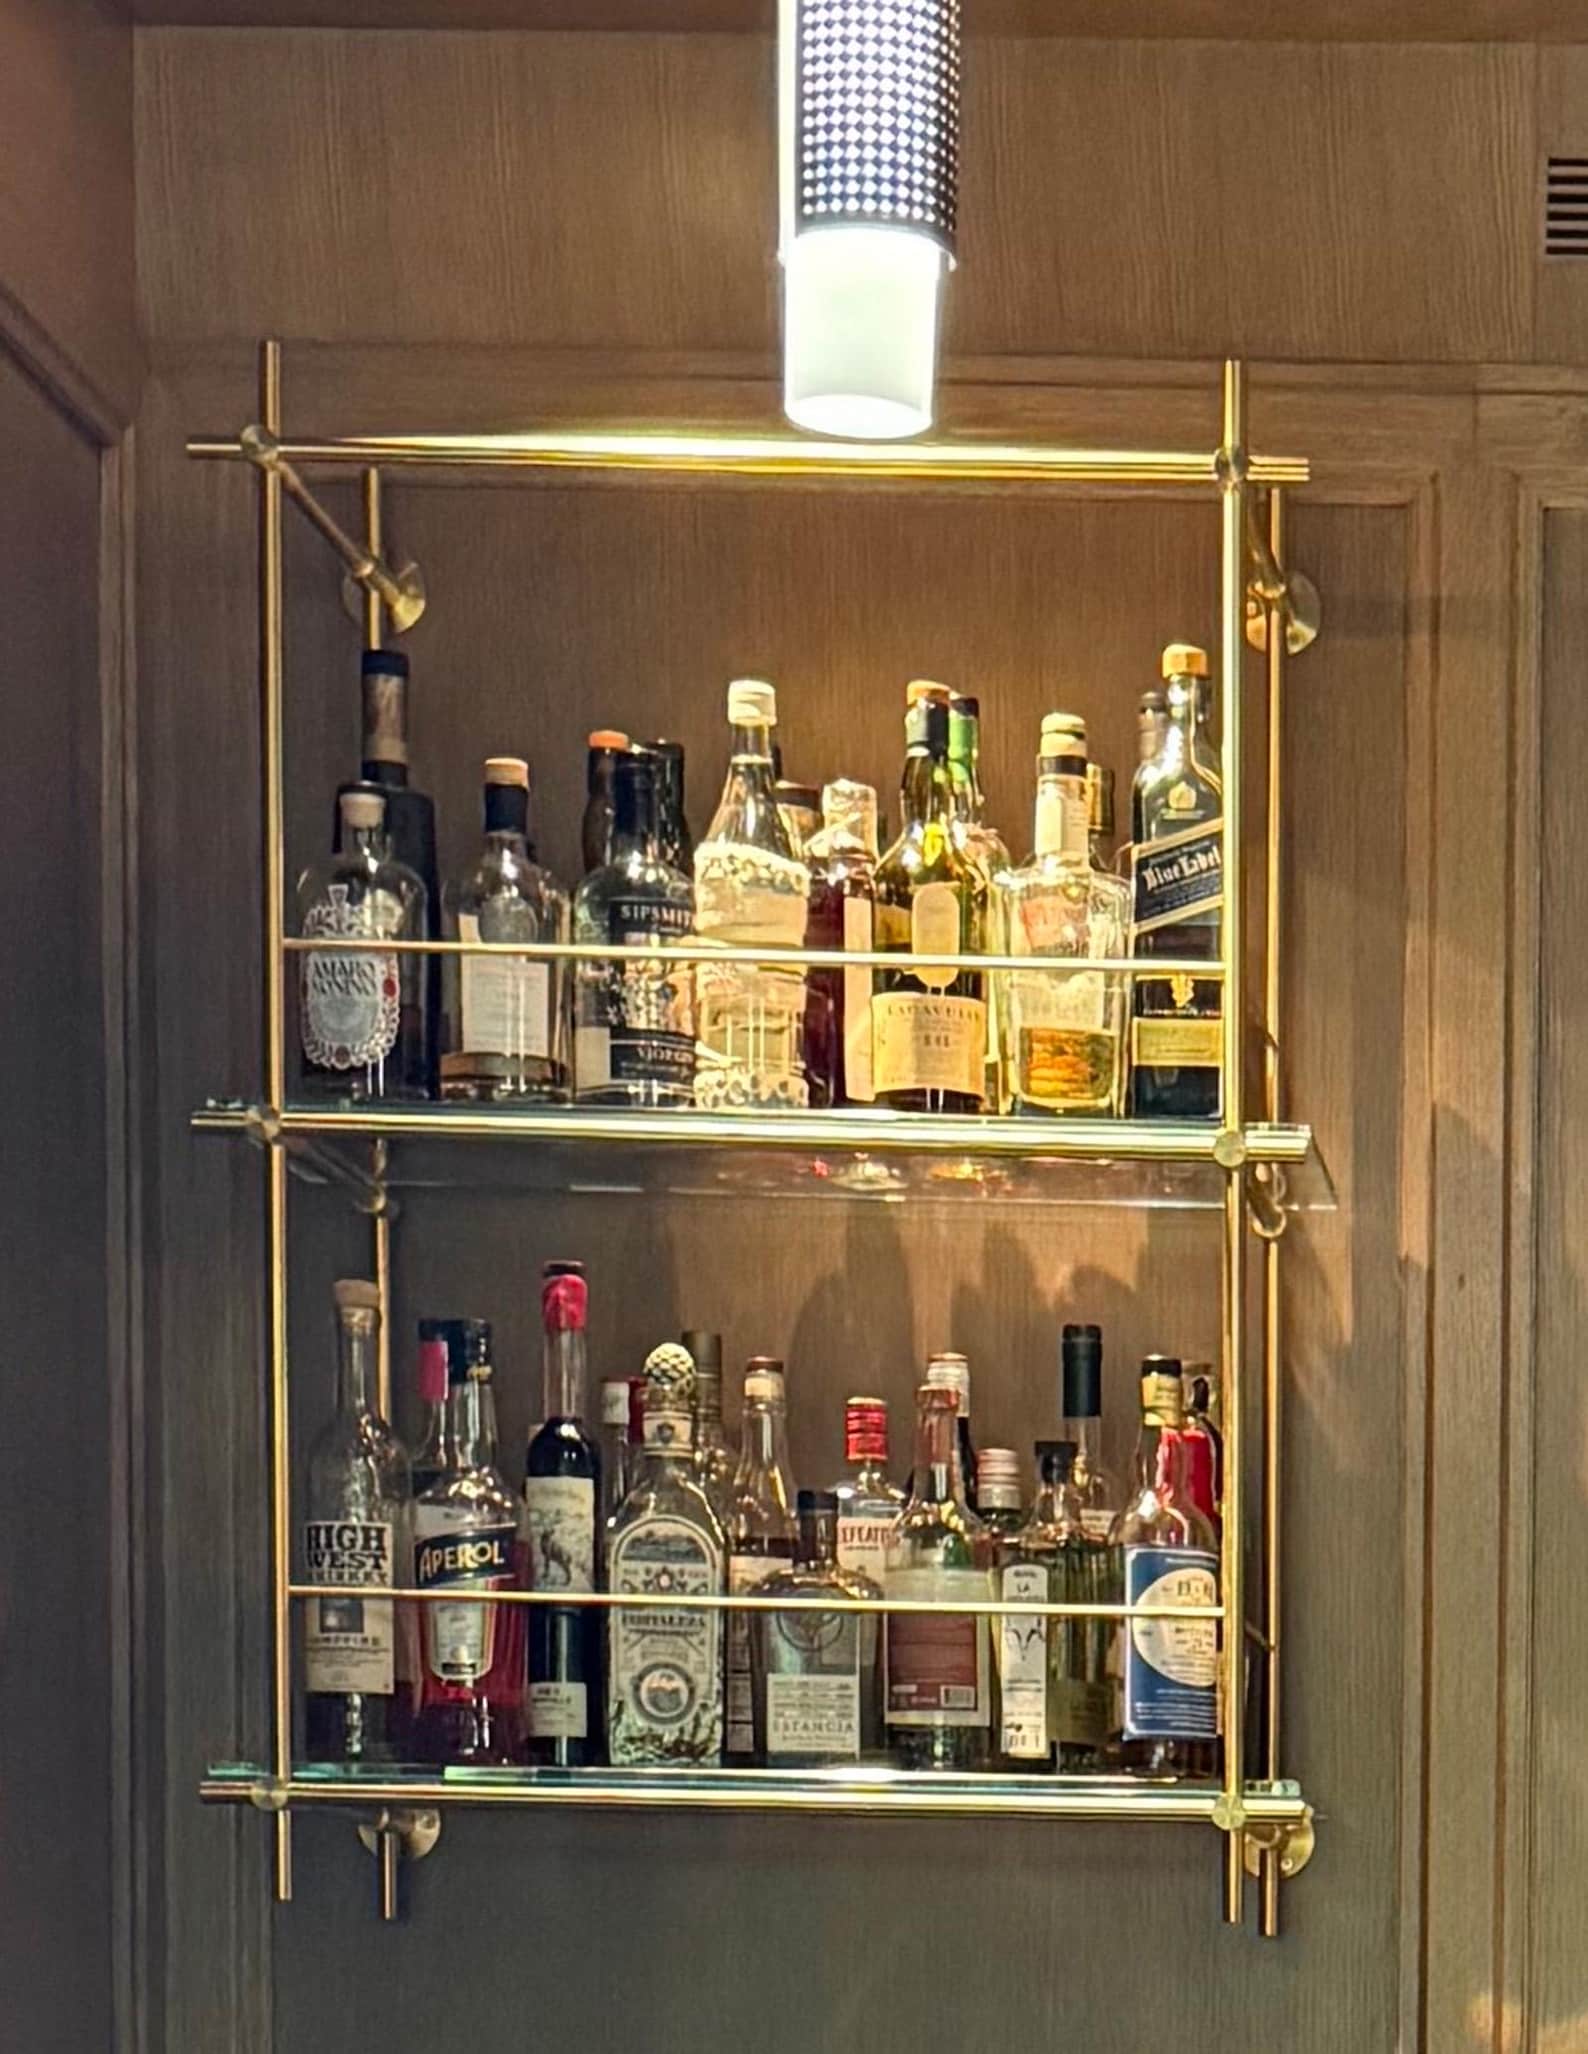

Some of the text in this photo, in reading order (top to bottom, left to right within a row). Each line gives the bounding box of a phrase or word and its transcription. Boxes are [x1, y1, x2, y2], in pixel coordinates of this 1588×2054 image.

[1142, 863, 1181, 892] Blue
[1178, 844, 1222, 880] Label
[312, 959, 377, 979] AMARO
[306, 1525, 386, 1551] HIGH
[306, 1551, 389, 1571] WEST
[418, 1540, 506, 1584] APEROL
[773, 1720, 855, 1734] ESTANCIA
